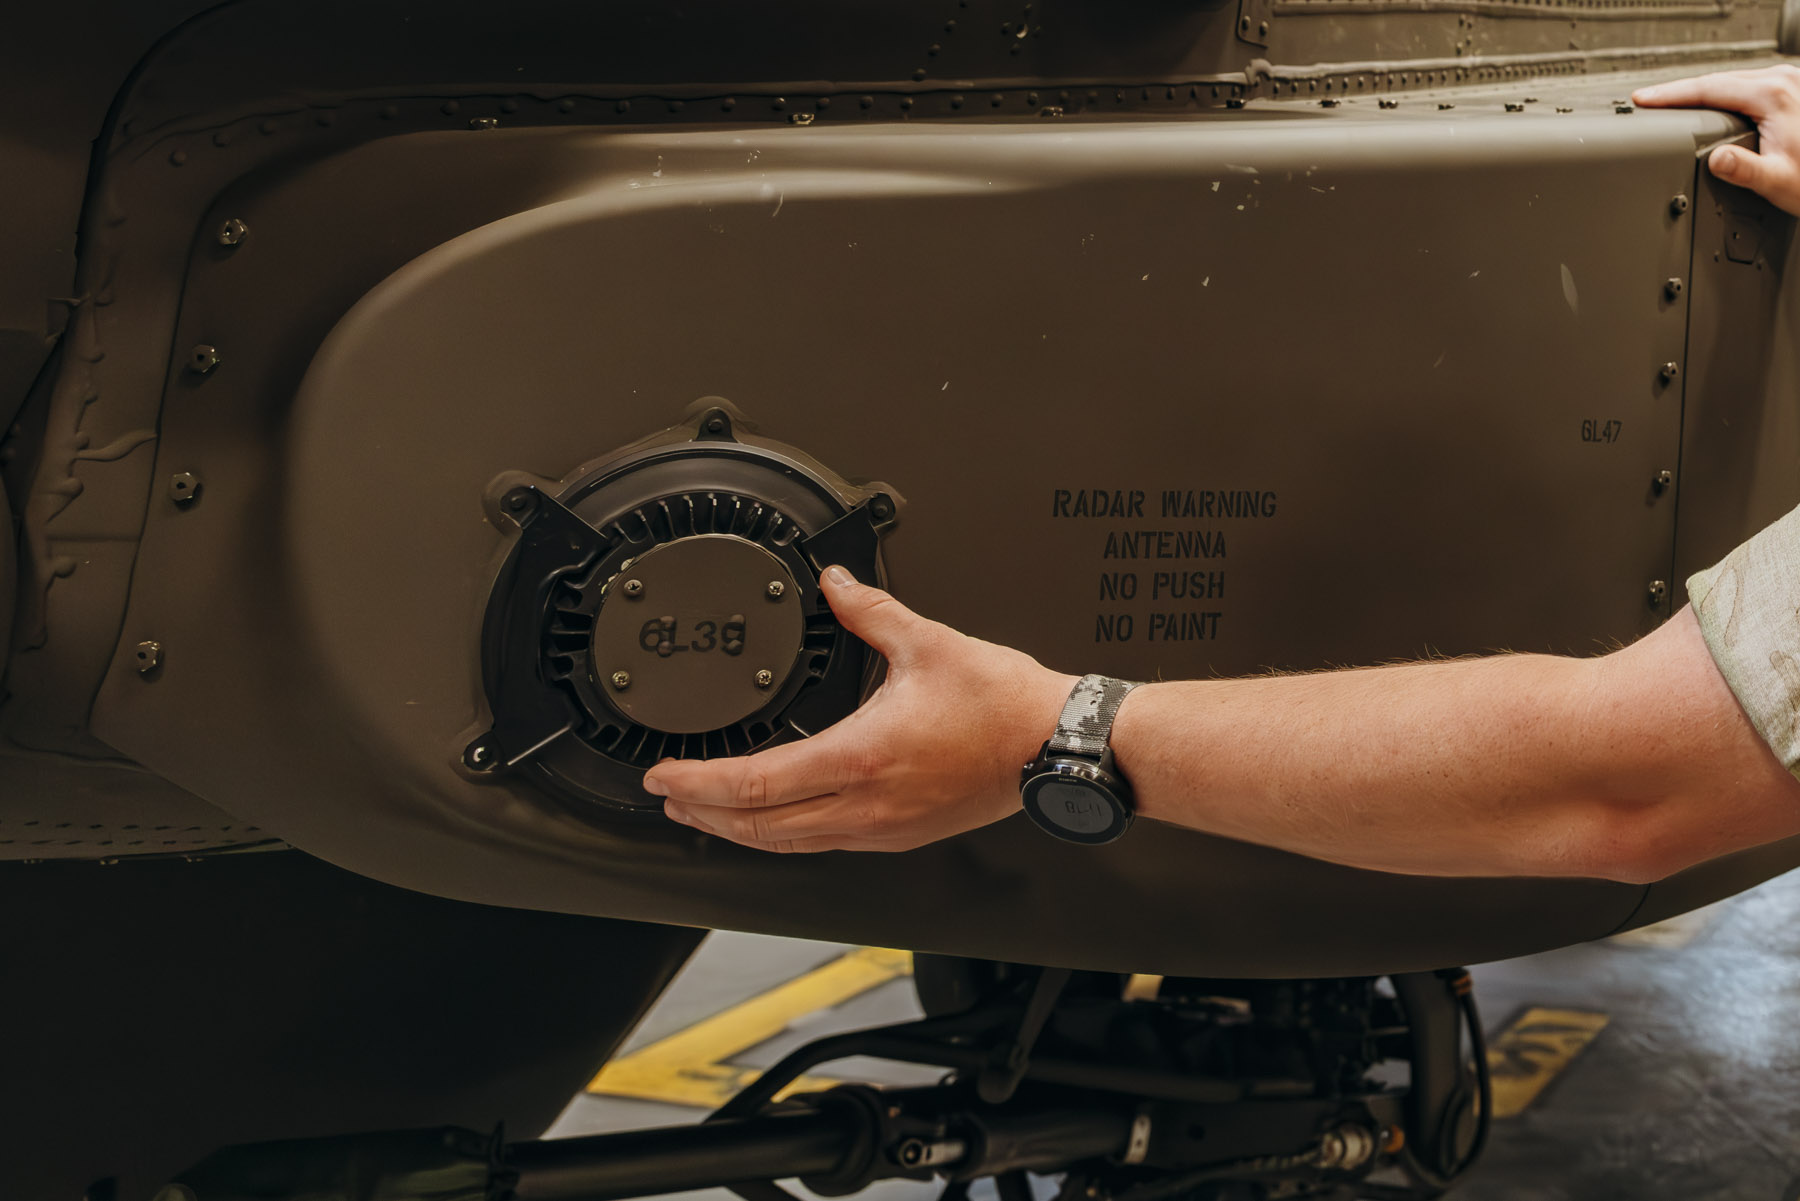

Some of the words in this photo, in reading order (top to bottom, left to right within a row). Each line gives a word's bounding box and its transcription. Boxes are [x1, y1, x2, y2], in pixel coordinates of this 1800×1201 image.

[1052, 489, 1146, 518] RADAR
[1161, 490, 1277, 518] WARNING
[1103, 531, 1227, 559] ANTENNA
[1101, 572, 1138, 600] NO
[1152, 571, 1225, 600] PUSH
[1095, 614, 1134, 643] NO
[1149, 612, 1223, 641] PAINT
